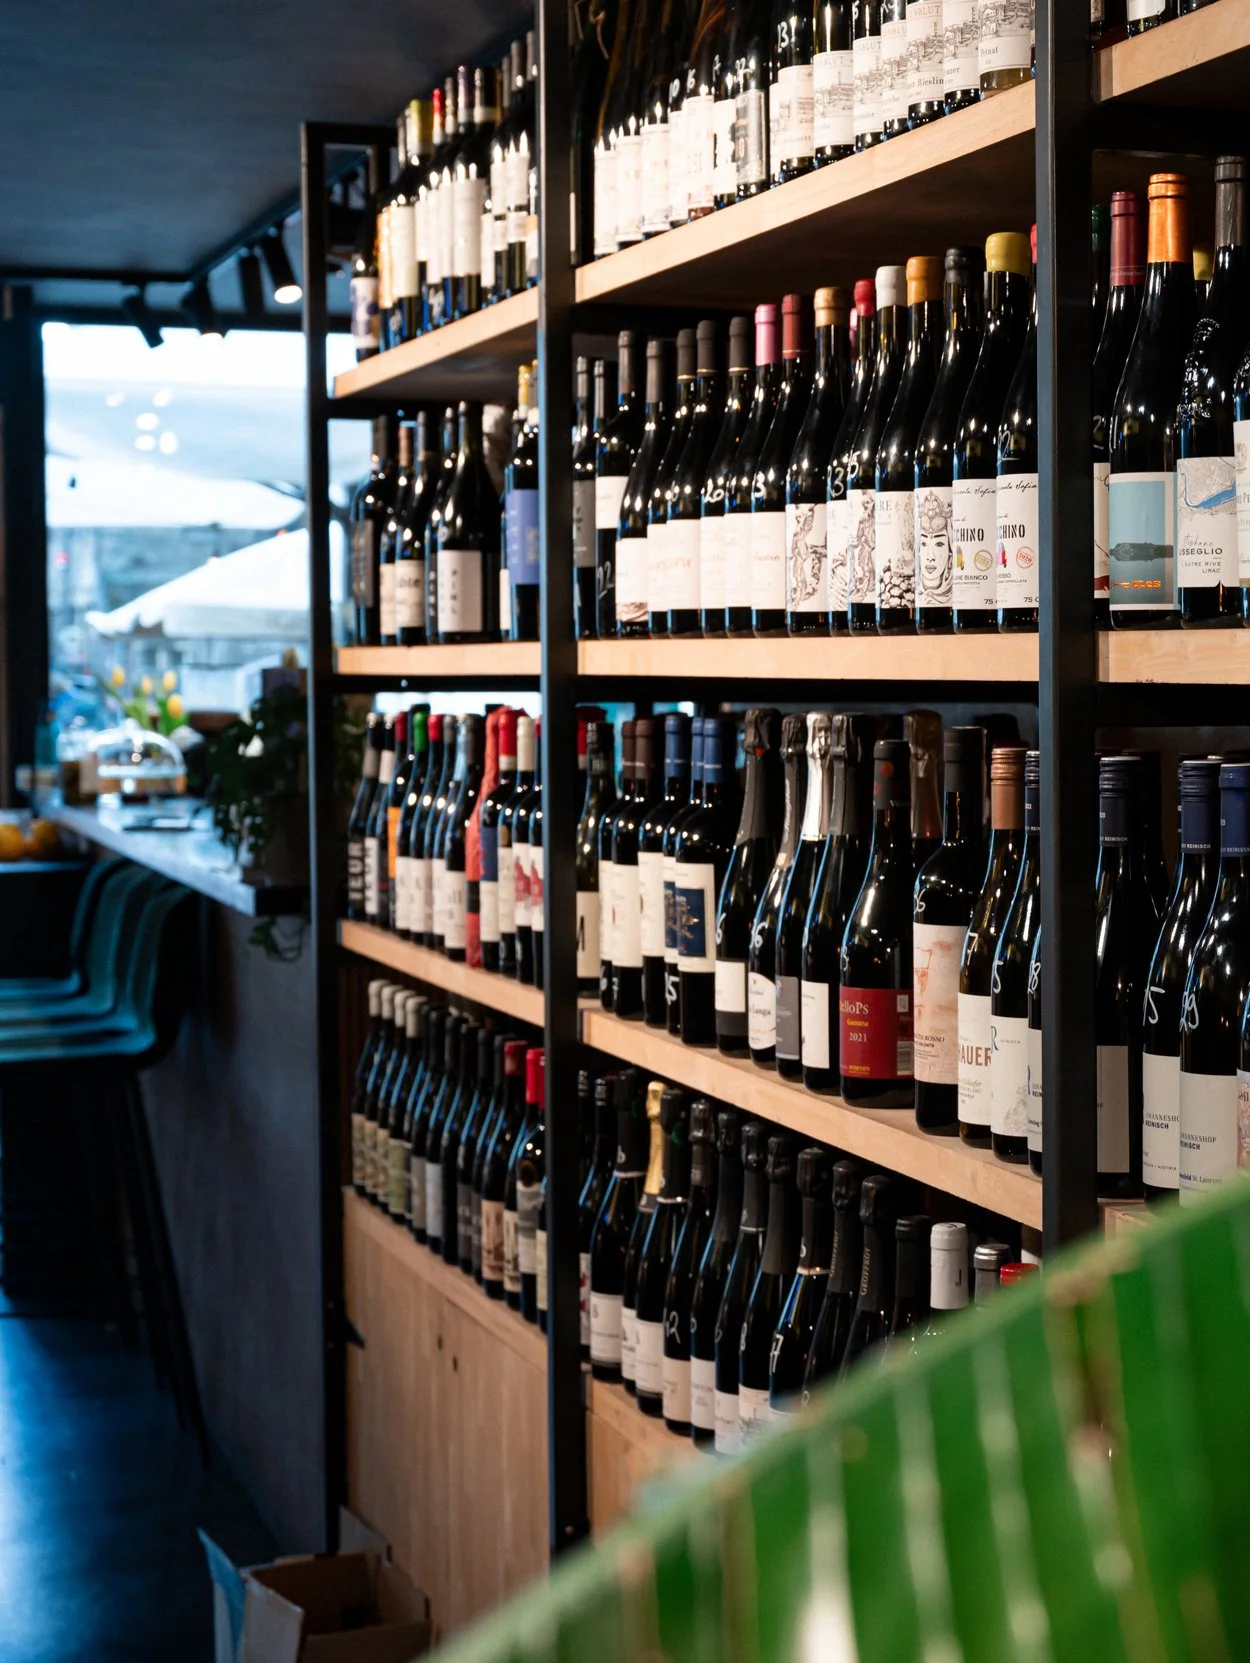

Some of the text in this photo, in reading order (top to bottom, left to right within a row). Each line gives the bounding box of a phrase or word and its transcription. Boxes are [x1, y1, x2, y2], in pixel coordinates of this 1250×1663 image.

[917, 75, 944, 88] Rieslin
[849, 1031, 867, 1042] 2021
[924, 1035, 945, 1043] ROSSO
[959, 1044, 991, 1067] AUER
